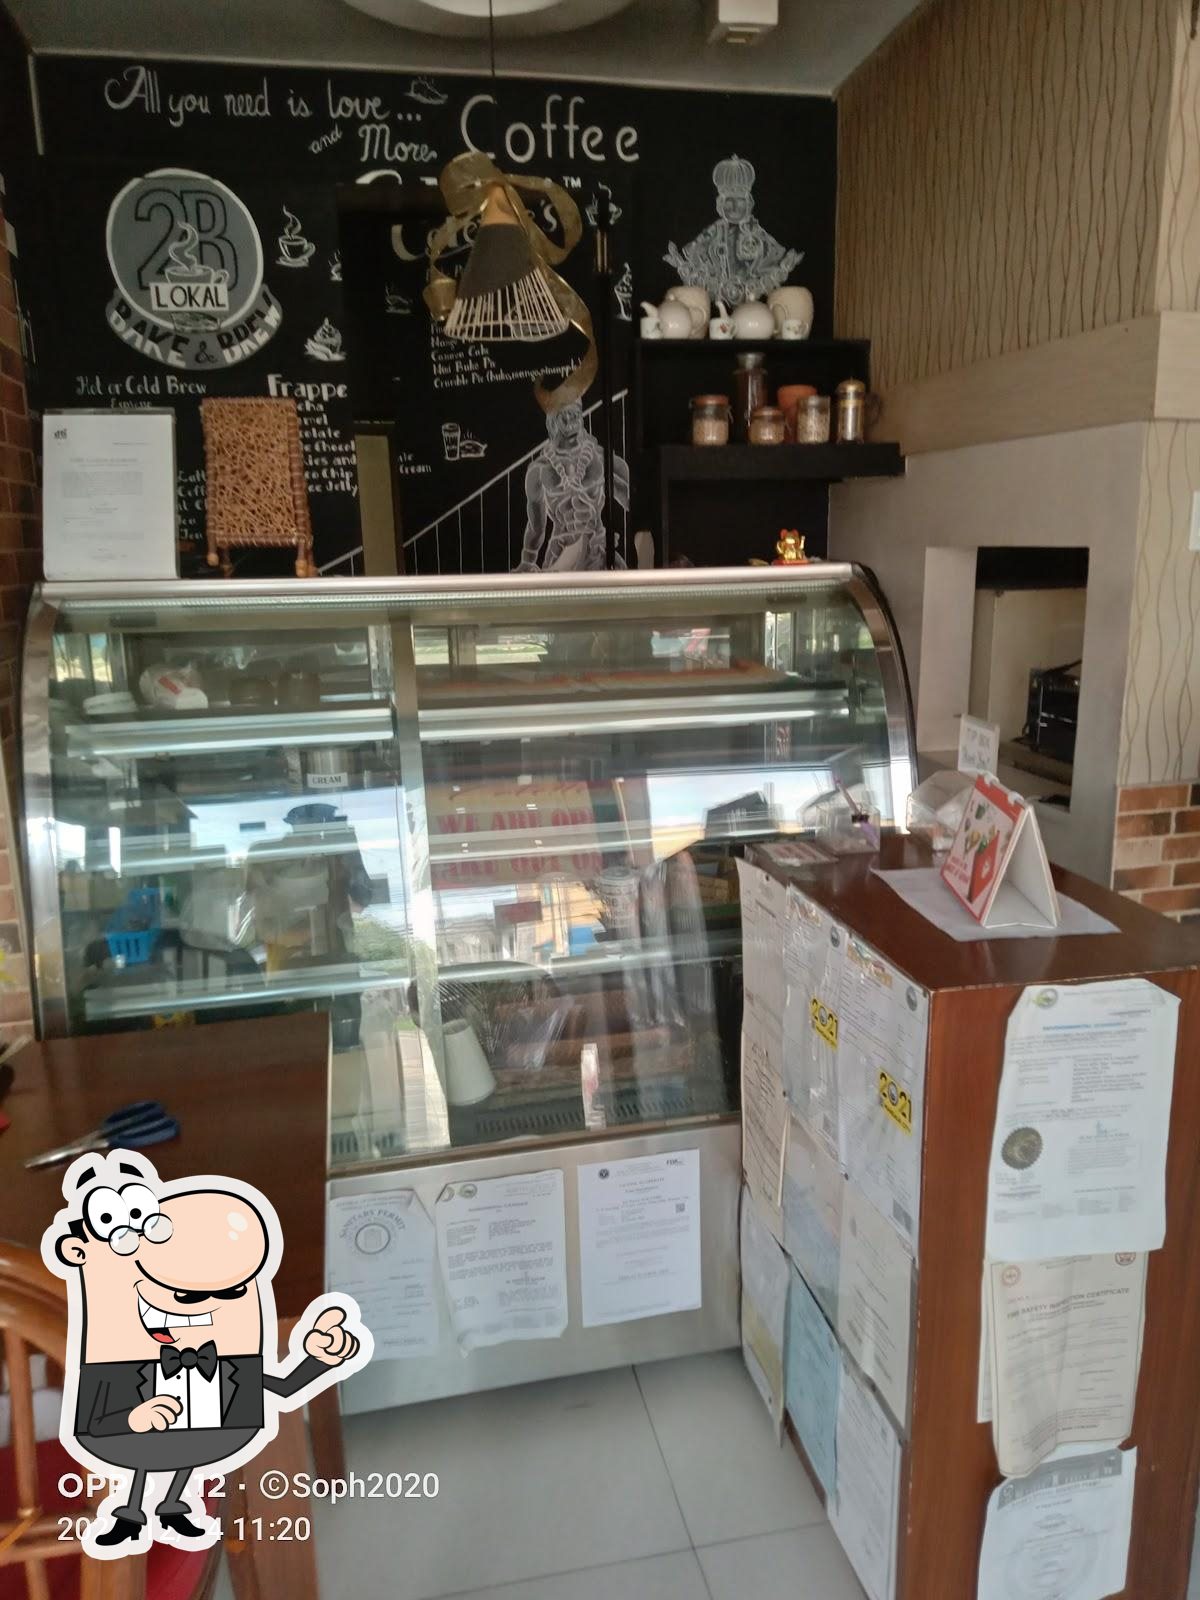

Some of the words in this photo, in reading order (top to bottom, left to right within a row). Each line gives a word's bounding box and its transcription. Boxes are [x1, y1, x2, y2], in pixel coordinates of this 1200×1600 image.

[104, 66, 161, 114] All
[169, 96, 211, 127] you
[226, 77, 271, 117] need
[288, 89, 313, 117] is
[308, 125, 343, 154] and
[459, 94, 640, 164] Coffee
[563, 176, 582, 188] TM
[134, 188, 239, 292] 2B
[154, 286, 227, 308] LOKAL
[124, 374, 160, 396] Cold
[165, 373, 207, 396] Brew
[266, 373, 348, 399] Frappe
[312, 776, 341, 784] CREAM
